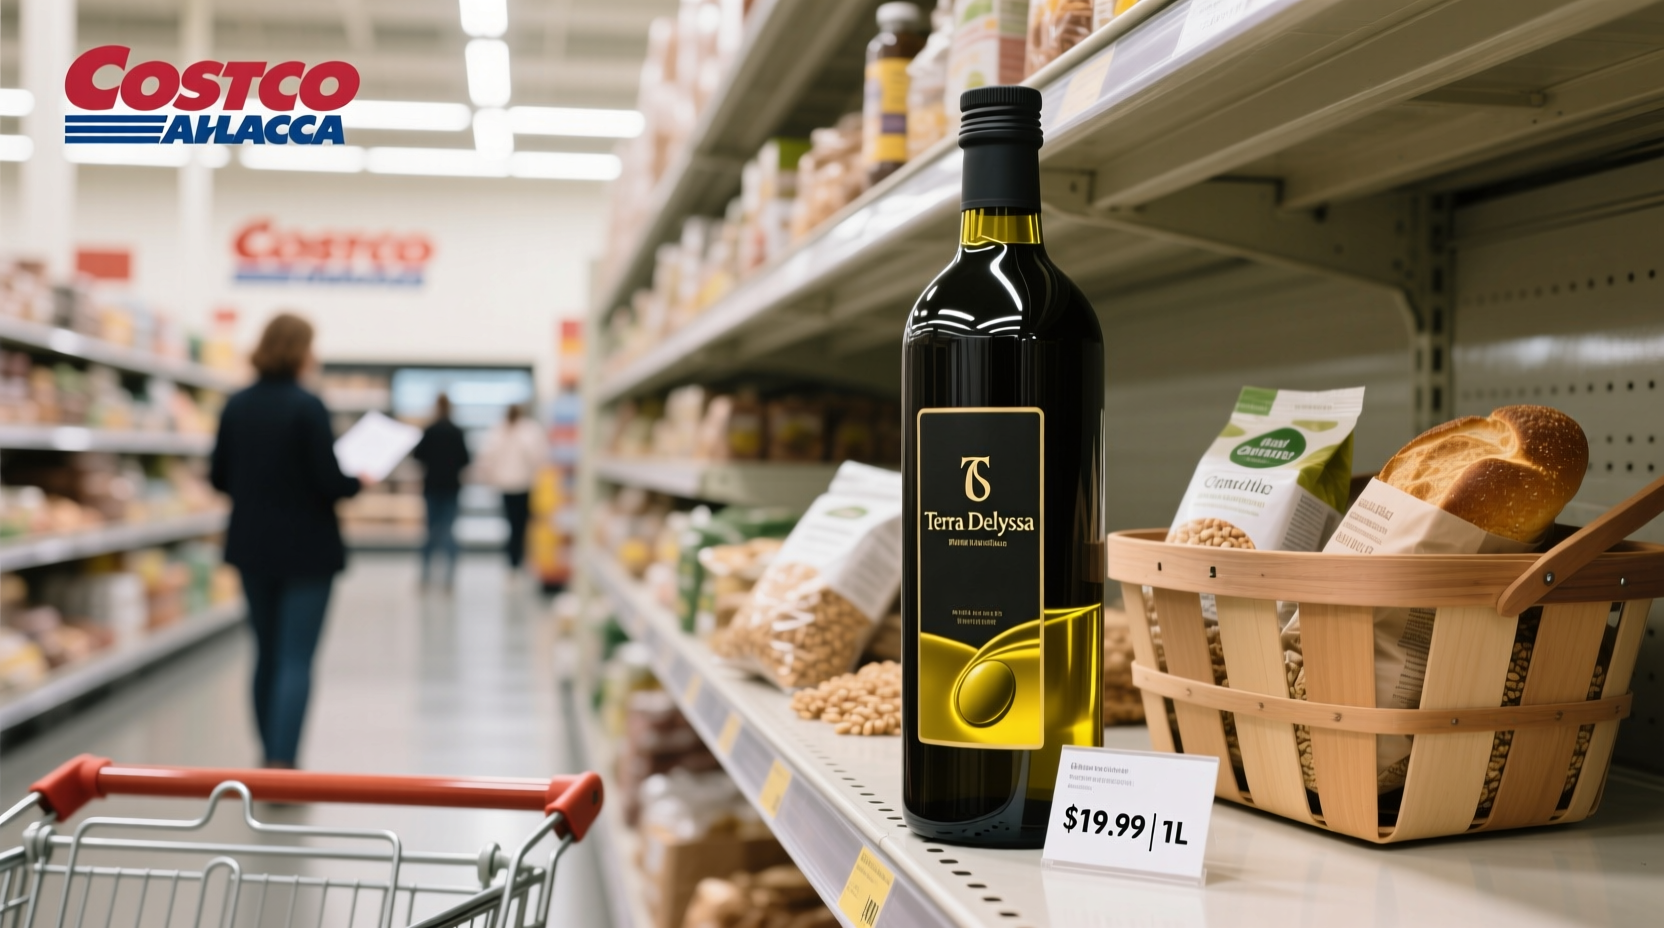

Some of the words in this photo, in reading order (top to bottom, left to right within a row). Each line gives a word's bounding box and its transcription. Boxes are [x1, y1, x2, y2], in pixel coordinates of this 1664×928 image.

[923, 511, 965, 531] Terra
[967, 510, 1035, 537] Delyssa
[1063, 803, 1146, 840] $19.99
[1162, 819, 1189, 846] 1L
